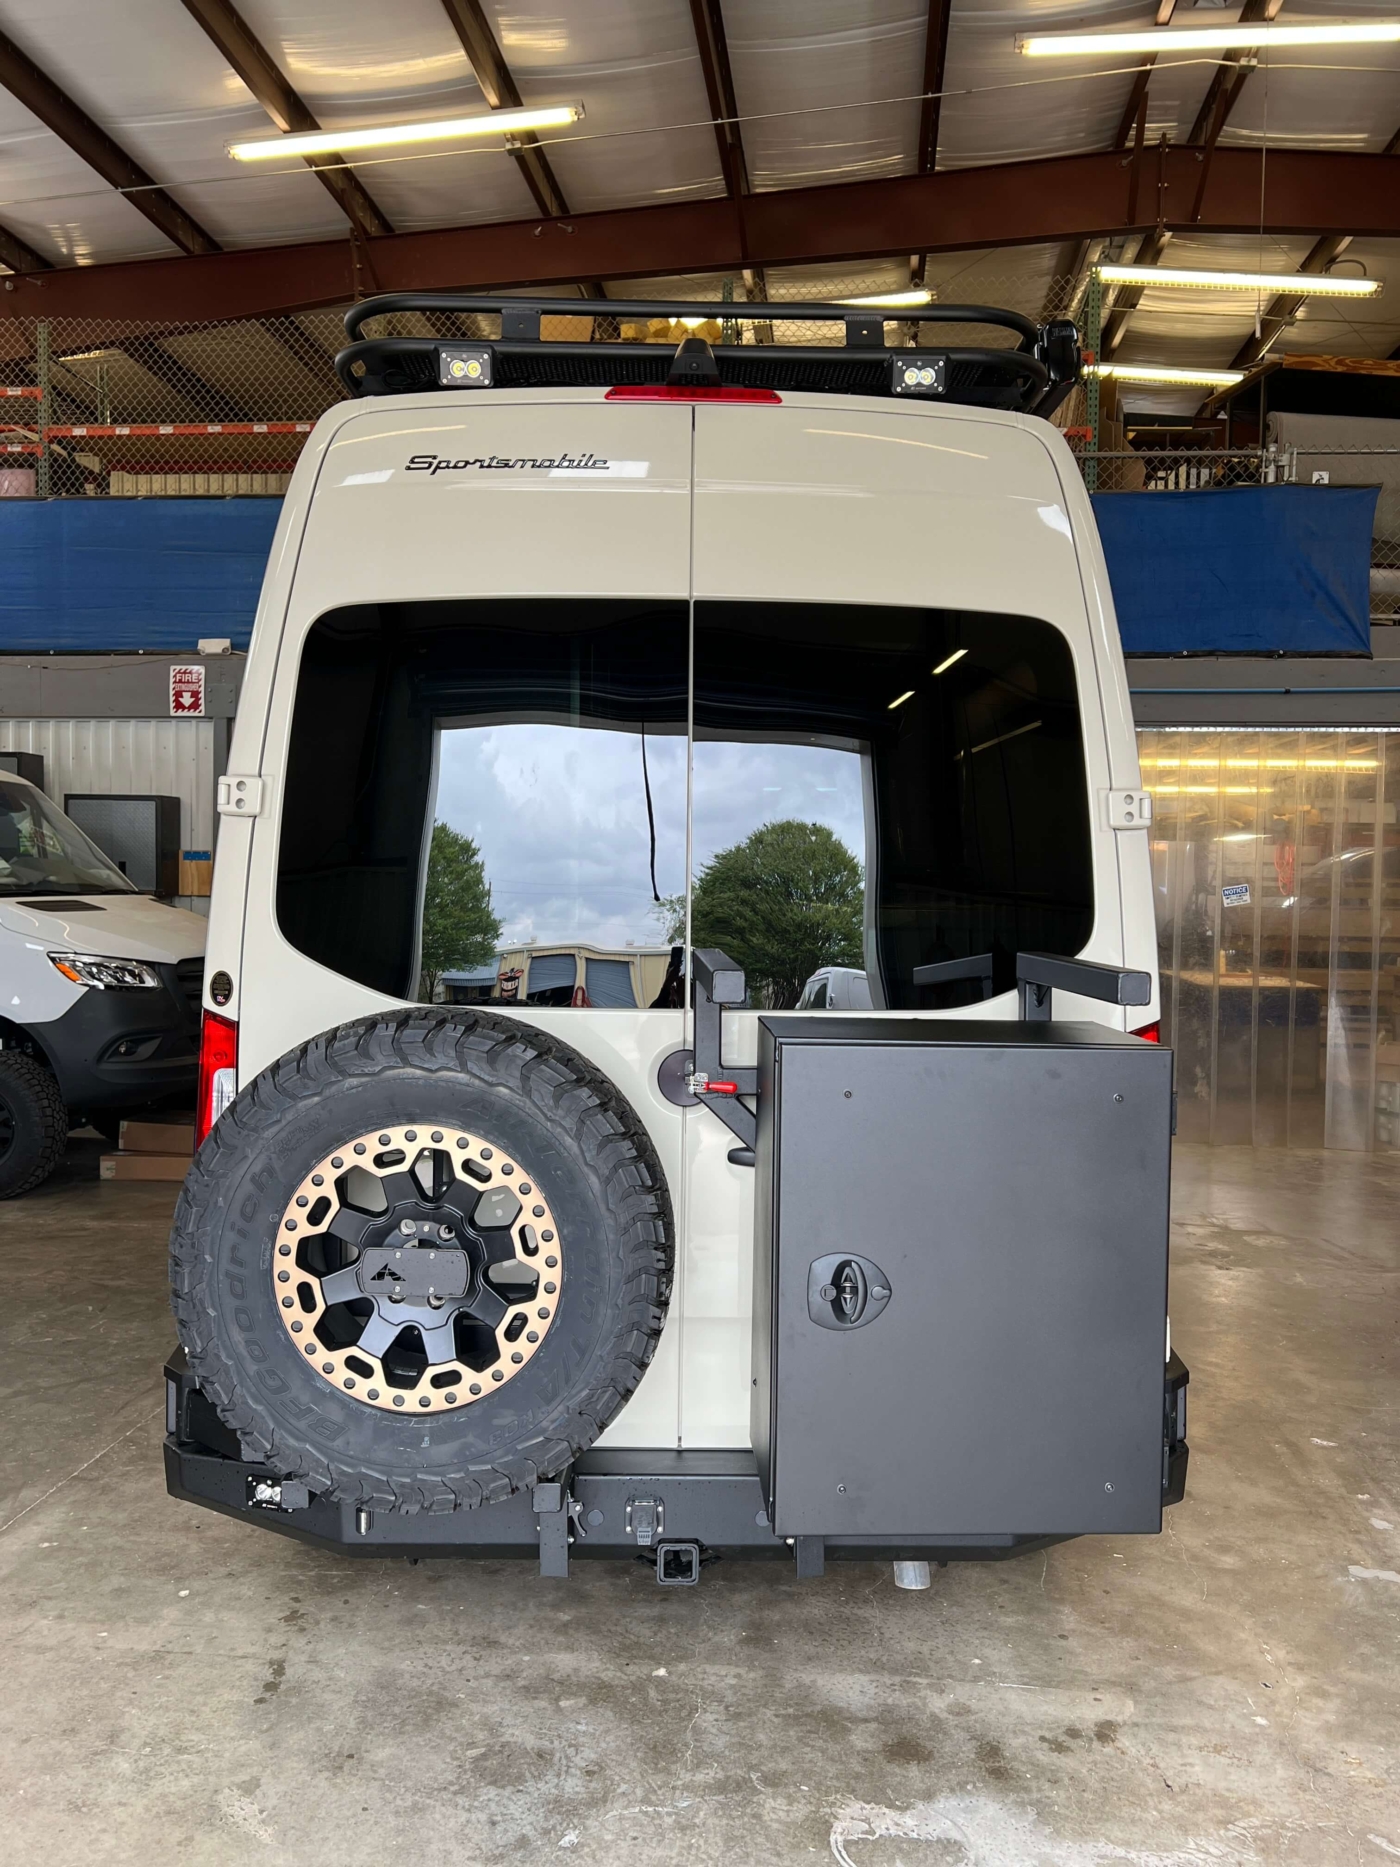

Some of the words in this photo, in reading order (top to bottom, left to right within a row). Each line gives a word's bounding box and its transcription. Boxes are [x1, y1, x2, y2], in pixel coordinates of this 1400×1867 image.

[405, 454, 610, 475] Sportsmobile
[176, 673, 199, 682] FIRE
[1224, 886, 1247, 896] NOTICE
[225, 1164, 349, 1442] BFGoodrich
